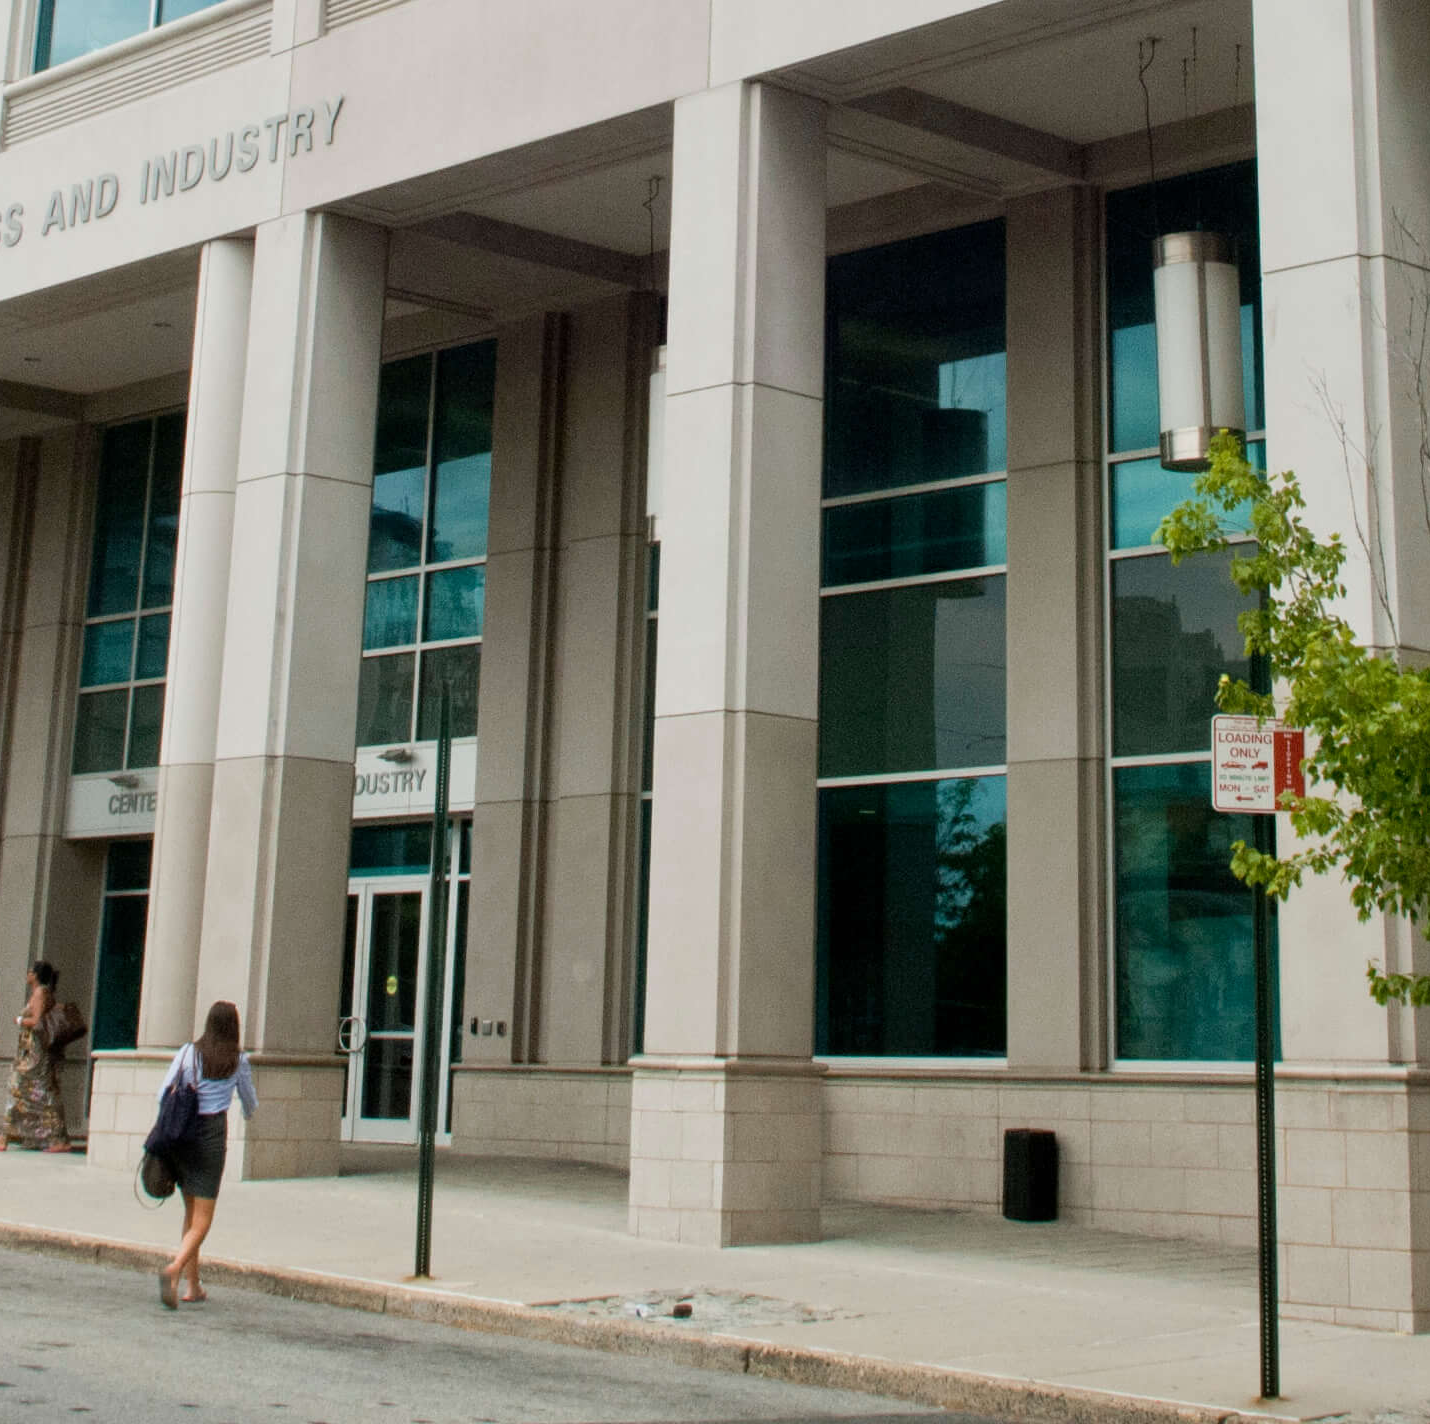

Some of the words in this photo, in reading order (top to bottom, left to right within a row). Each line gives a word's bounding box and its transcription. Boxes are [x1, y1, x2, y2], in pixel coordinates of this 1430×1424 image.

[42, 172, 120, 236] AND
[141, 96, 345, 204] INDUSTRY
[1218, 733, 1272, 744] LOADING
[1230, 747, 1259, 758] ONLY
[355, 768, 427, 795] DUSTRY
[1219, 784, 1241, 792] MON
[1253, 785, 1270, 793] SAT
[109, 791, 156, 815] CENTE
